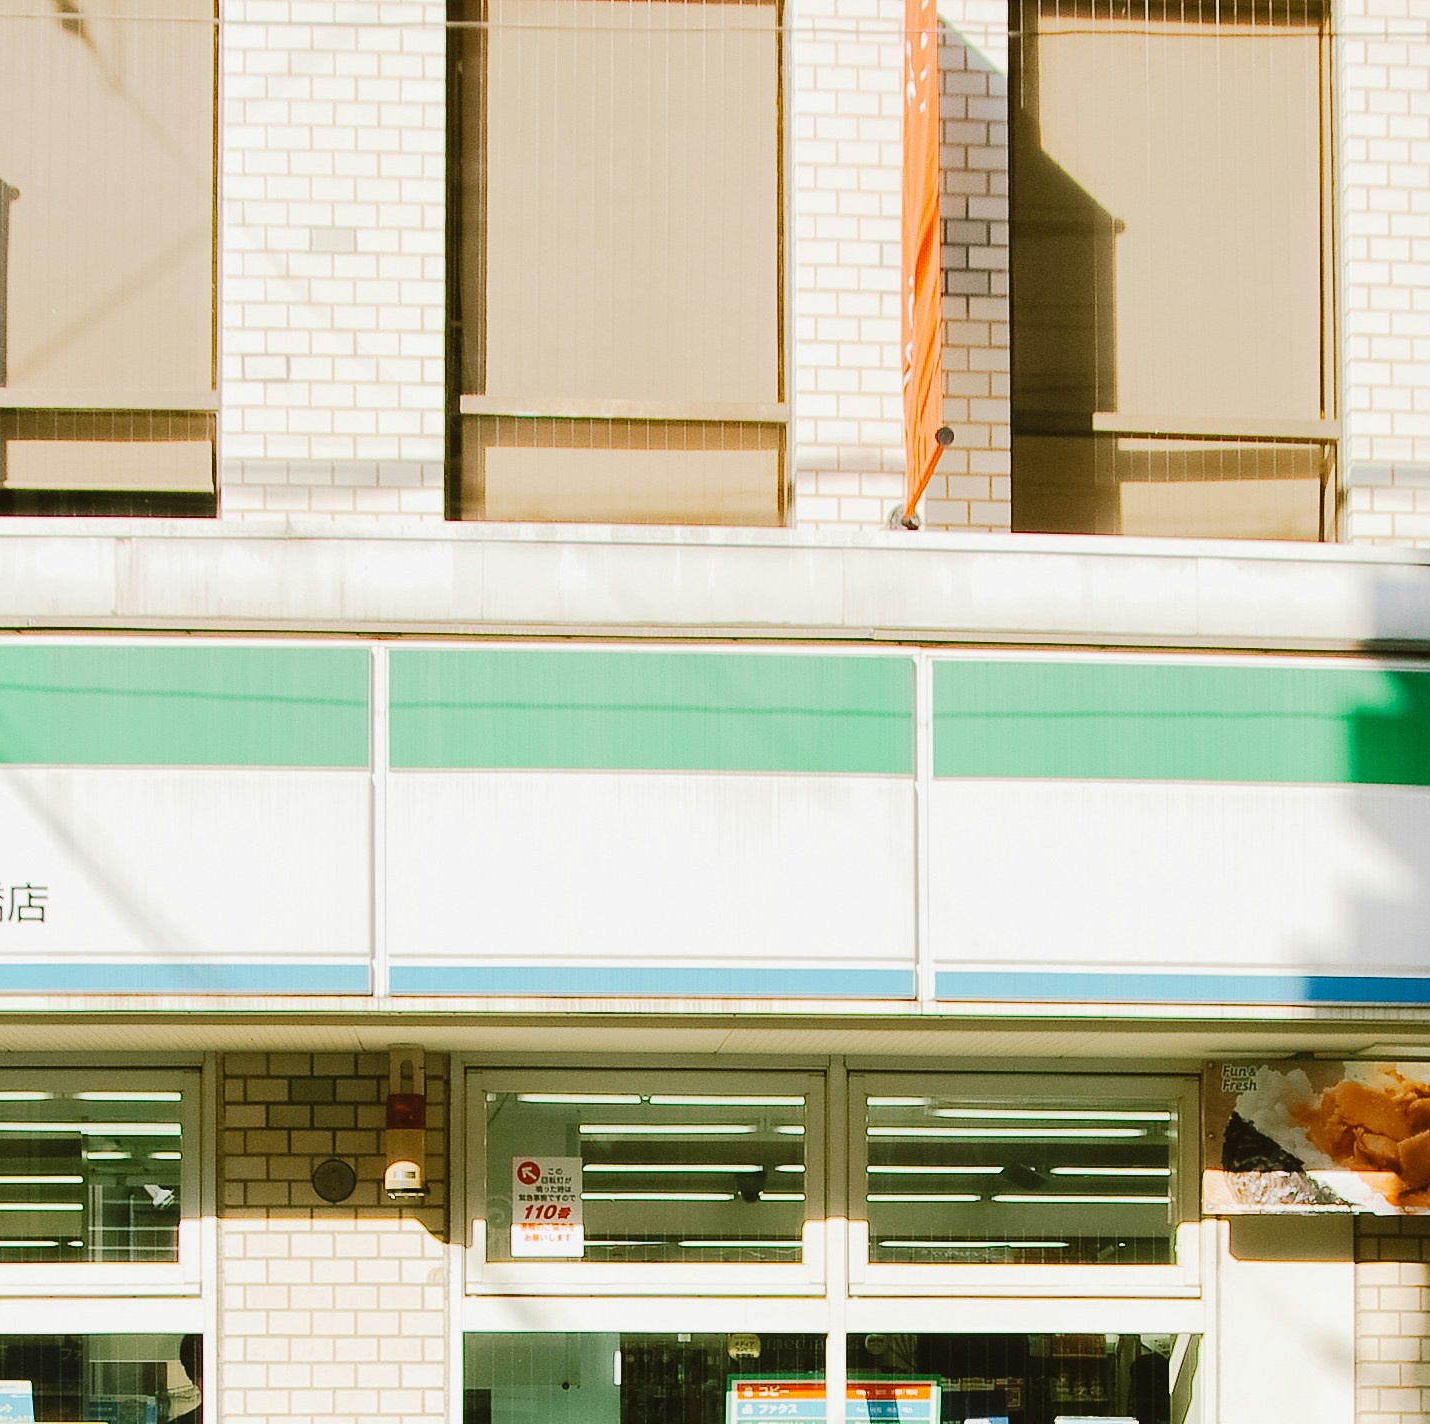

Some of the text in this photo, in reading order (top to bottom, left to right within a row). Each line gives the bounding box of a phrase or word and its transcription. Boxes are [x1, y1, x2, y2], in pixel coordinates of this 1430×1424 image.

[1222, 1064, 1257, 1077] Fun &
[1222, 1080, 1258, 1092] Fresh
[524, 1204, 572, 1220] 110番
[758, 1386, 791, 1397] コピー
[758, 1403, 799, 1415] ファクス
